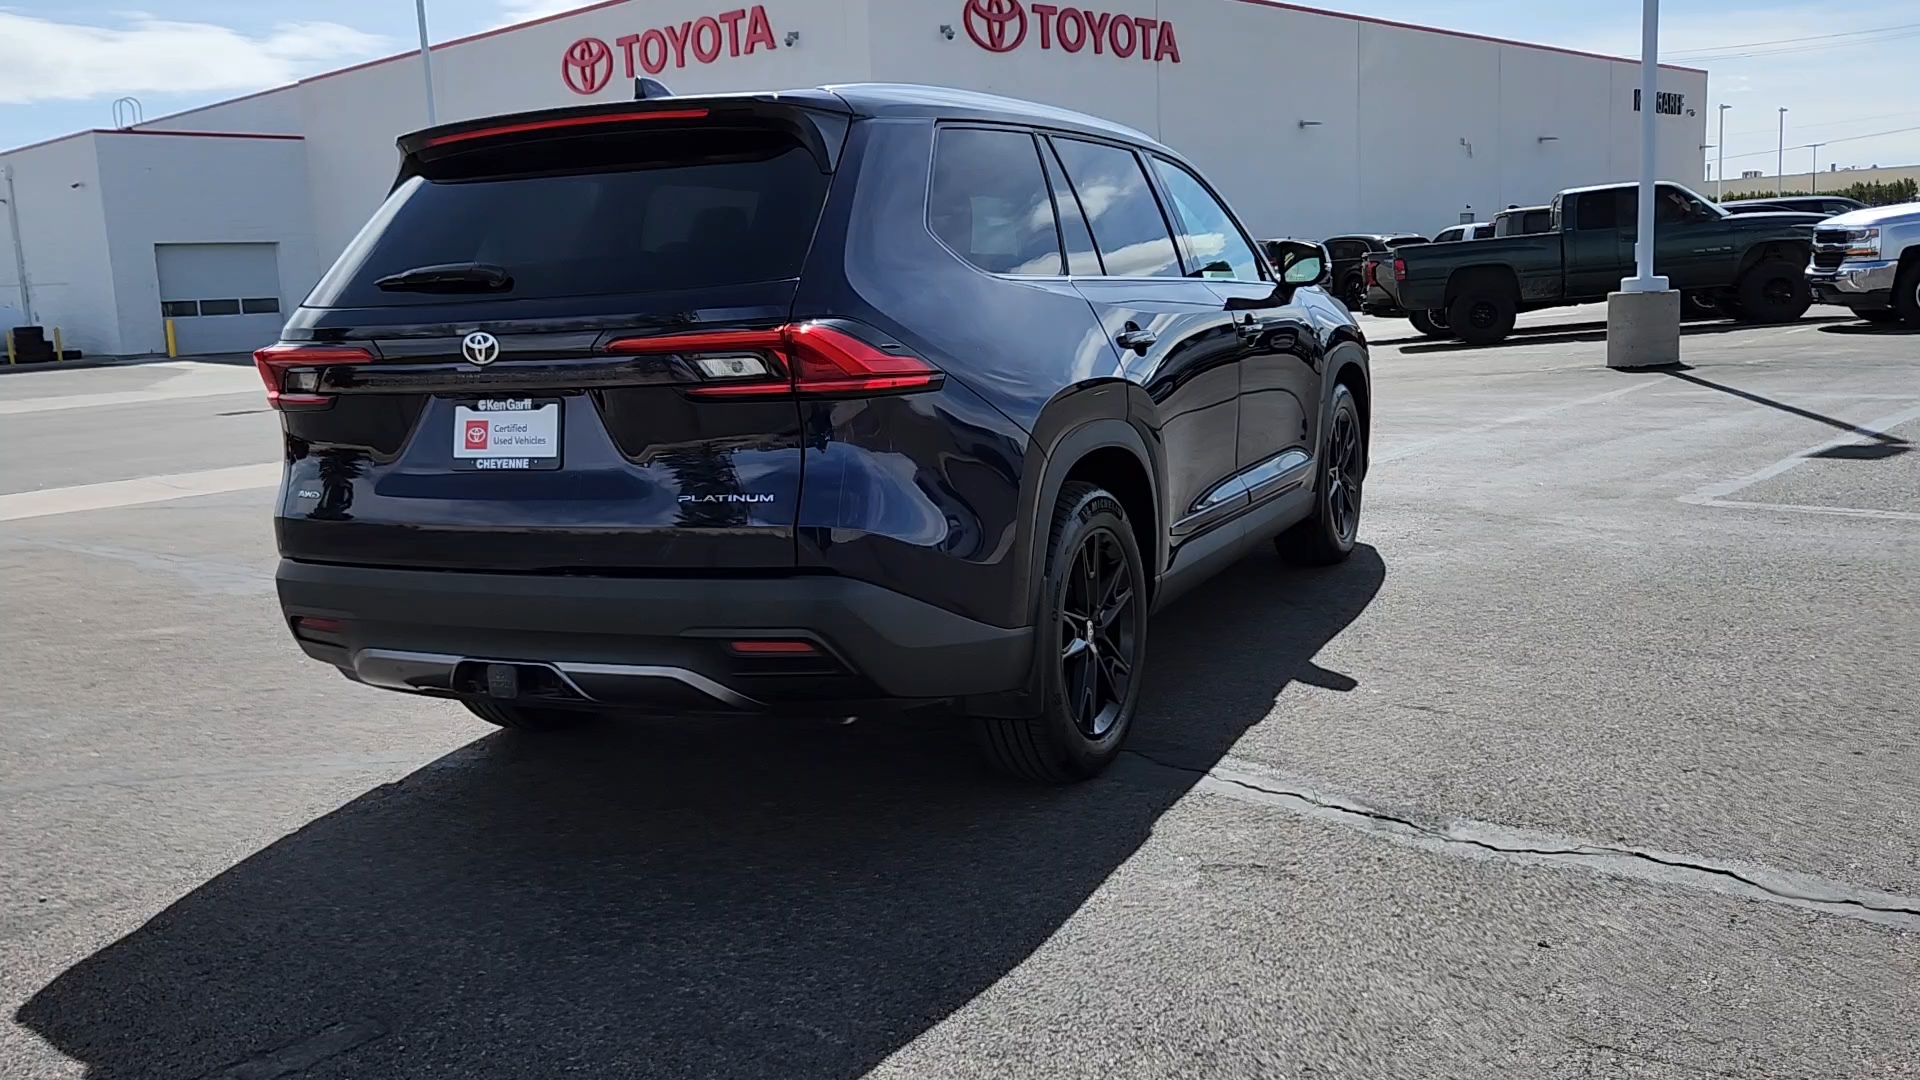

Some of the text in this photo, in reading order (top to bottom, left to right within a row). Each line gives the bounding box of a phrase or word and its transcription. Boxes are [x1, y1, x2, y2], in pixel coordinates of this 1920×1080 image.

[1031, 3, 1181, 63] TOYOTA
[616, 5, 777, 78] TOYOTA
[493, 423, 528, 433] Certified
[493, 435, 547, 445] Used Vehicles
[476, 458, 530, 469] CHEYENNE
[298, 490, 320, 498] AWD
[677, 494, 775, 503] PLATINUM
